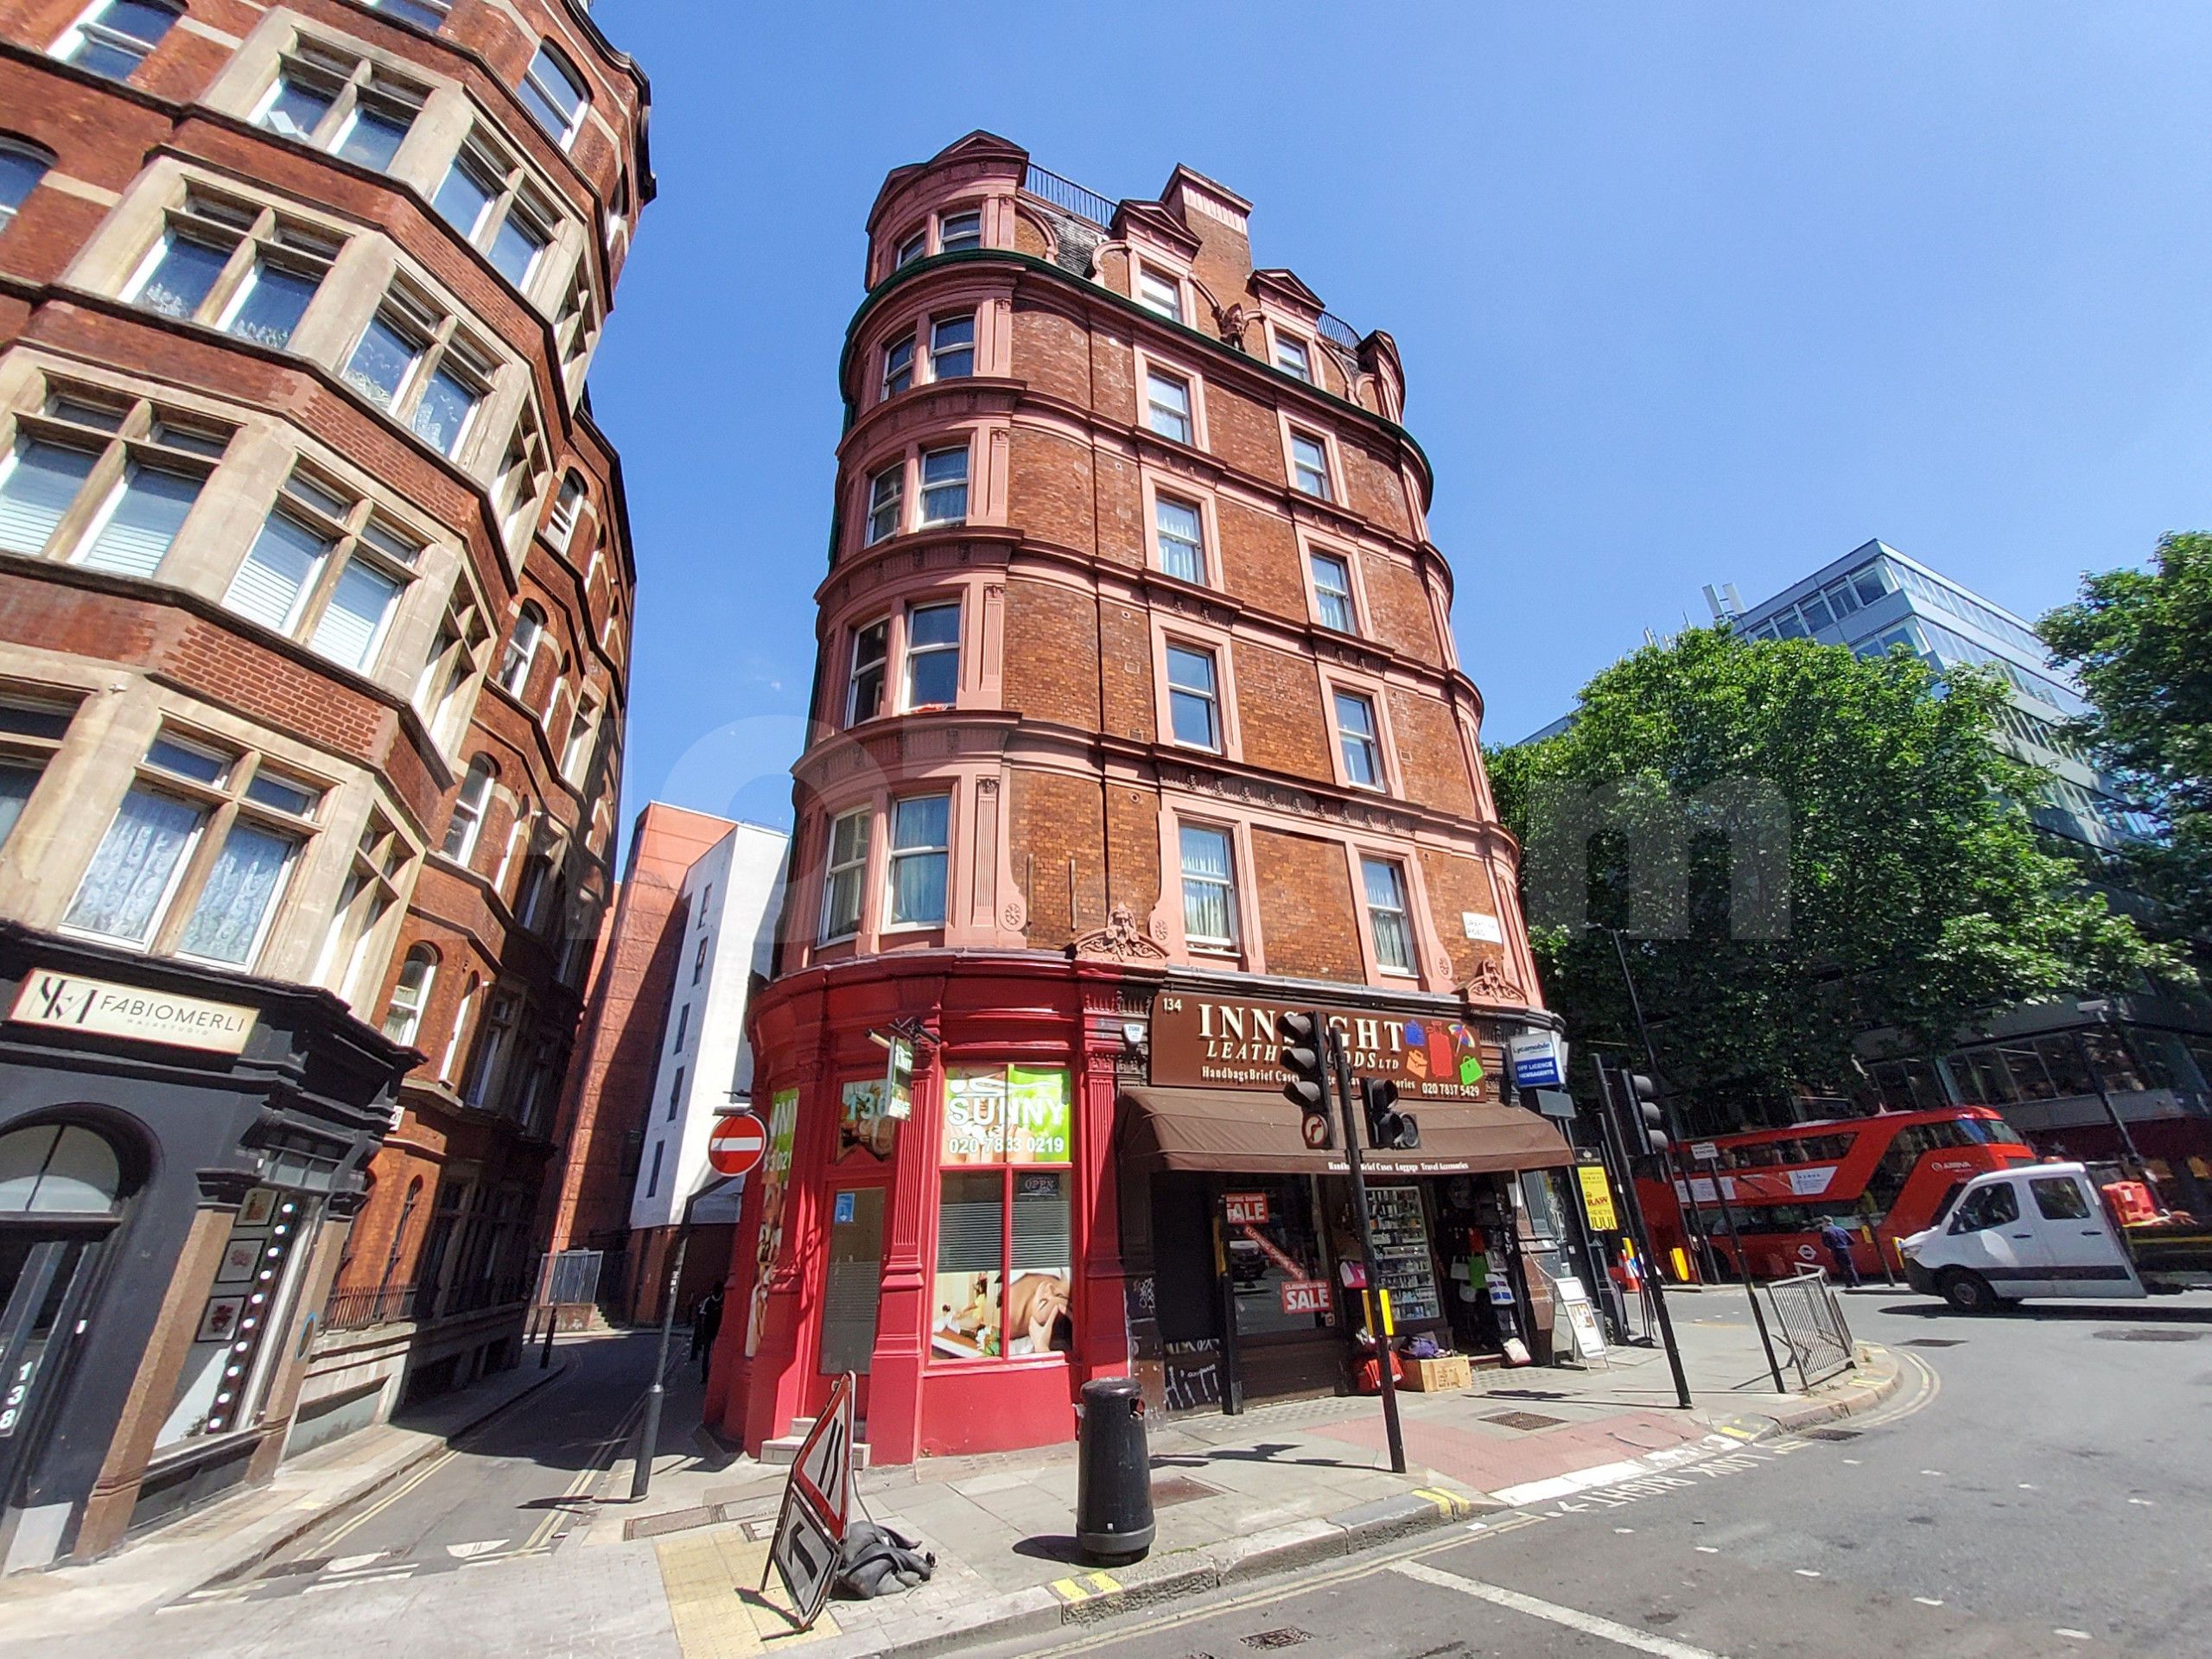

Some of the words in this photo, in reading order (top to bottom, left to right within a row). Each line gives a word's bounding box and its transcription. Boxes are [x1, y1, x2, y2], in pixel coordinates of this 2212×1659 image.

[1163, 997, 1183, 1012] 134
[99, 995, 245, 1033] FABIOMERLI
[1198, 1003, 1404, 1052] INNGHT
[1206, 1040, 1294, 1063] LEATH
[1378, 1058, 1400, 1070] LTD
[1513, 1042, 1551, 1054] Lycamobile
[1202, 1065, 1249, 1083] Handbags
[1249, 1069, 1274, 1081] Brief
[1529, 1061, 1554, 1070] LICENCE
[1421, 1082, 1439, 1096] 020
[1440, 1084, 1459, 1096] 7837
[1459, 1084, 1480, 1097] 5429
[947, 1096, 1064, 1127] SUNNY
[949, 1137, 979, 1154] 020
[1026, 1136, 1065, 1154] 0219
[1025, 1178, 1054, 1191] OPEN
[1586, 1196, 1608, 1206] RAW
[1286, 1288, 1330, 1311] SALE
[1678, 1453, 1776, 1478] LOOK
[1578, 1476, 1698, 1509] RIGHT
